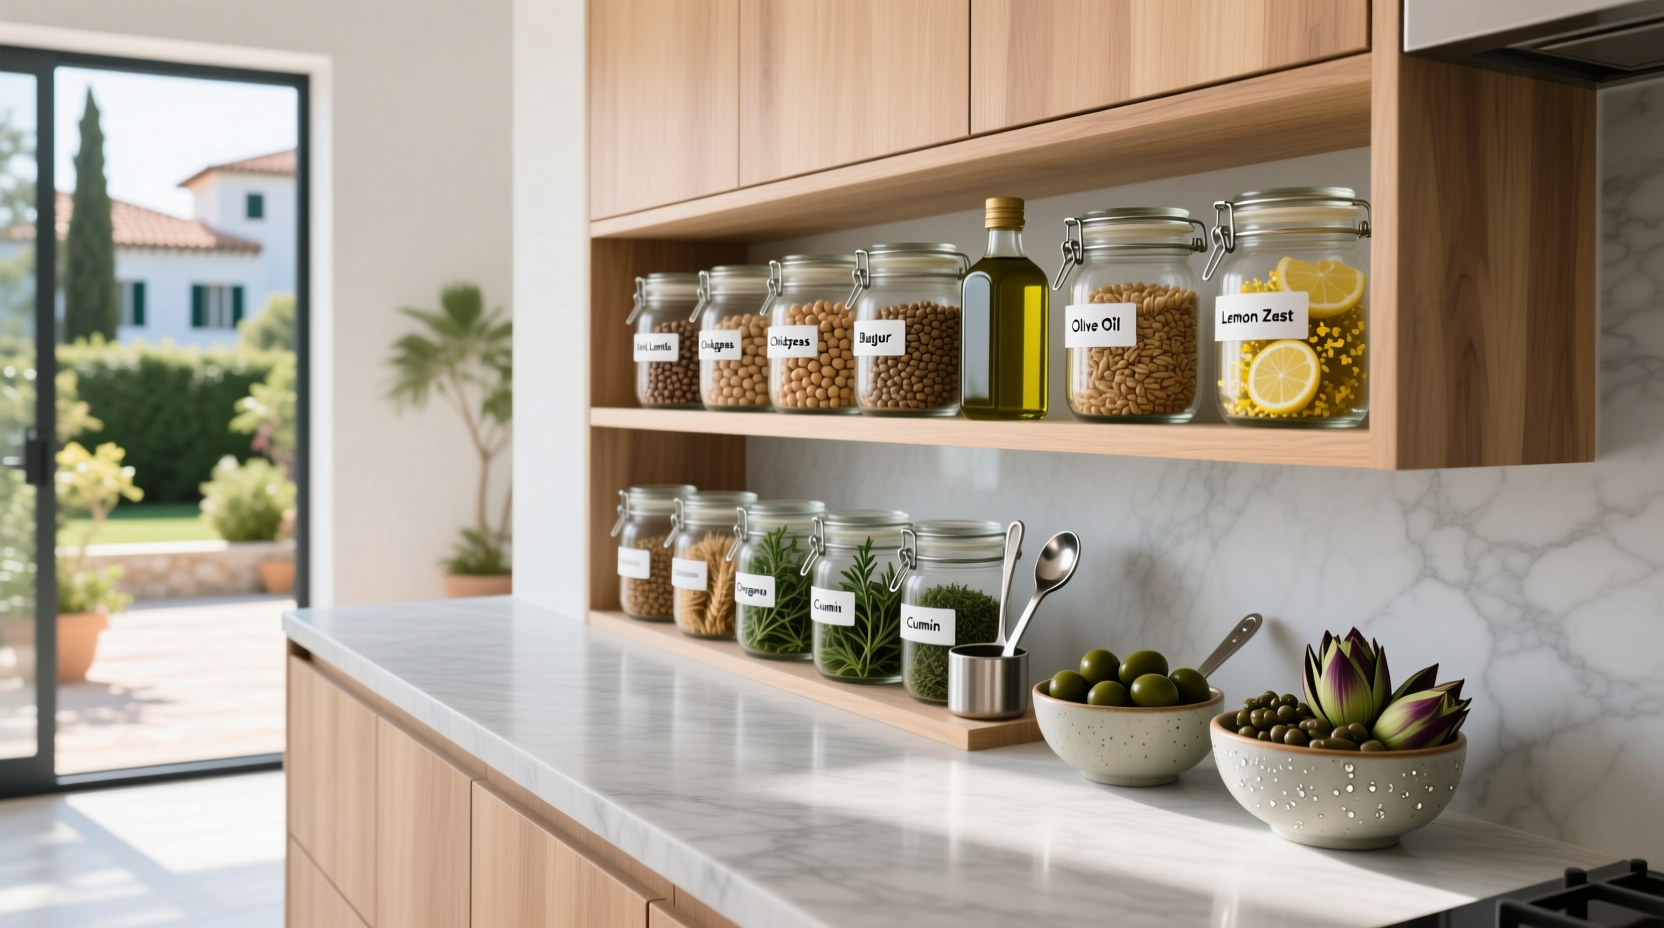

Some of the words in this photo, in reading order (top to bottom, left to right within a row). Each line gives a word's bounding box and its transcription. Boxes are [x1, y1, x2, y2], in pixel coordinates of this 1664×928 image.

[1071, 318, 1098, 333] Olive
[1101, 316, 1120, 331] Oil
[1221, 311, 1258, 324] Lemon
[906, 616, 940, 632] Cumin
